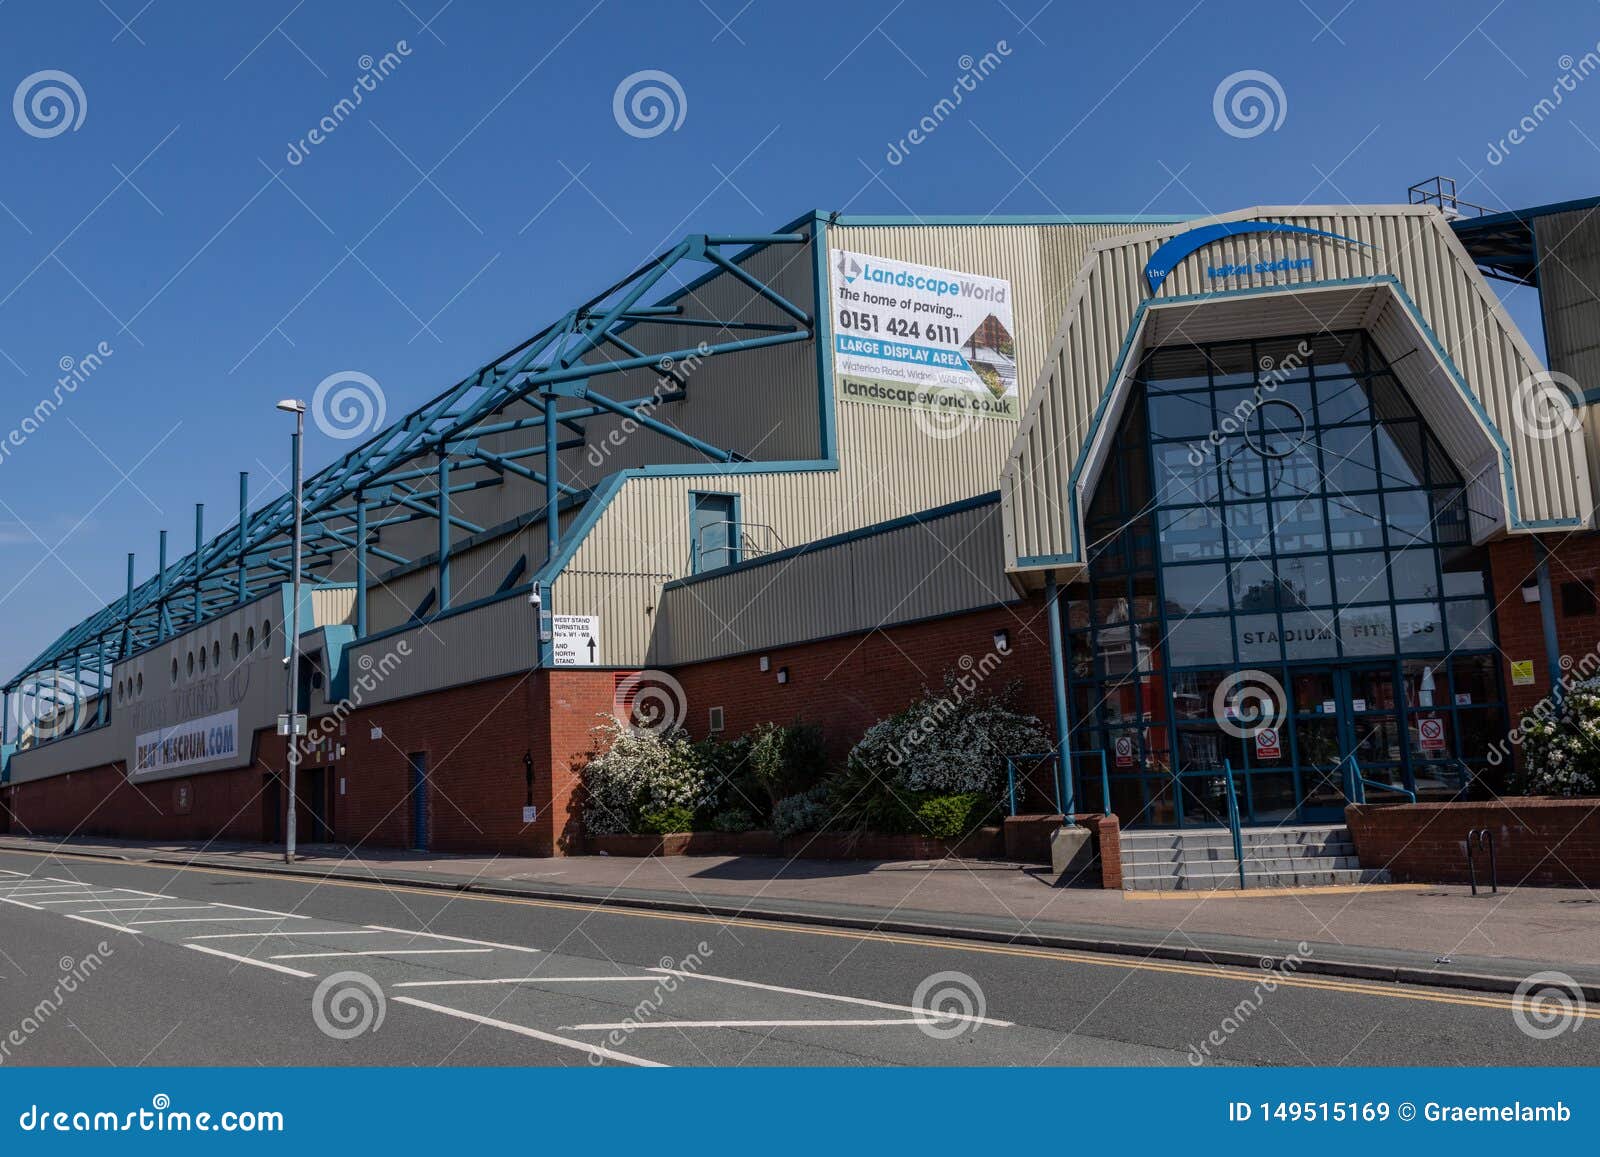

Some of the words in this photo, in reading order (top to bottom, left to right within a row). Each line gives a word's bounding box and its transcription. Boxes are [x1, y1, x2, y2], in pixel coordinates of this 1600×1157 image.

[1149, 268, 1165, 278] the
[1255, 256, 1313, 273] stadium
[863, 263, 1006, 304] LandscapeWorld
[839, 287, 860, 301] The
[863, 291, 897, 308] home
[900, 298, 912, 310] of
[913, 301, 963, 319] paving...
[839, 309, 879, 333] 0151
[886, 317, 921, 340] 424
[925, 323, 960, 345] 6111
[840, 338, 880, 355] LARGE
[883, 343, 930, 362] DISPLAY
[933, 351, 963, 367] AREA
[841, 360, 881, 374] Waterloo
[881, 366, 906, 379] Road,
[842, 379, 1012, 414] landscapeworld.co.uk
[1243, 630, 1333, 645] STADIUM
